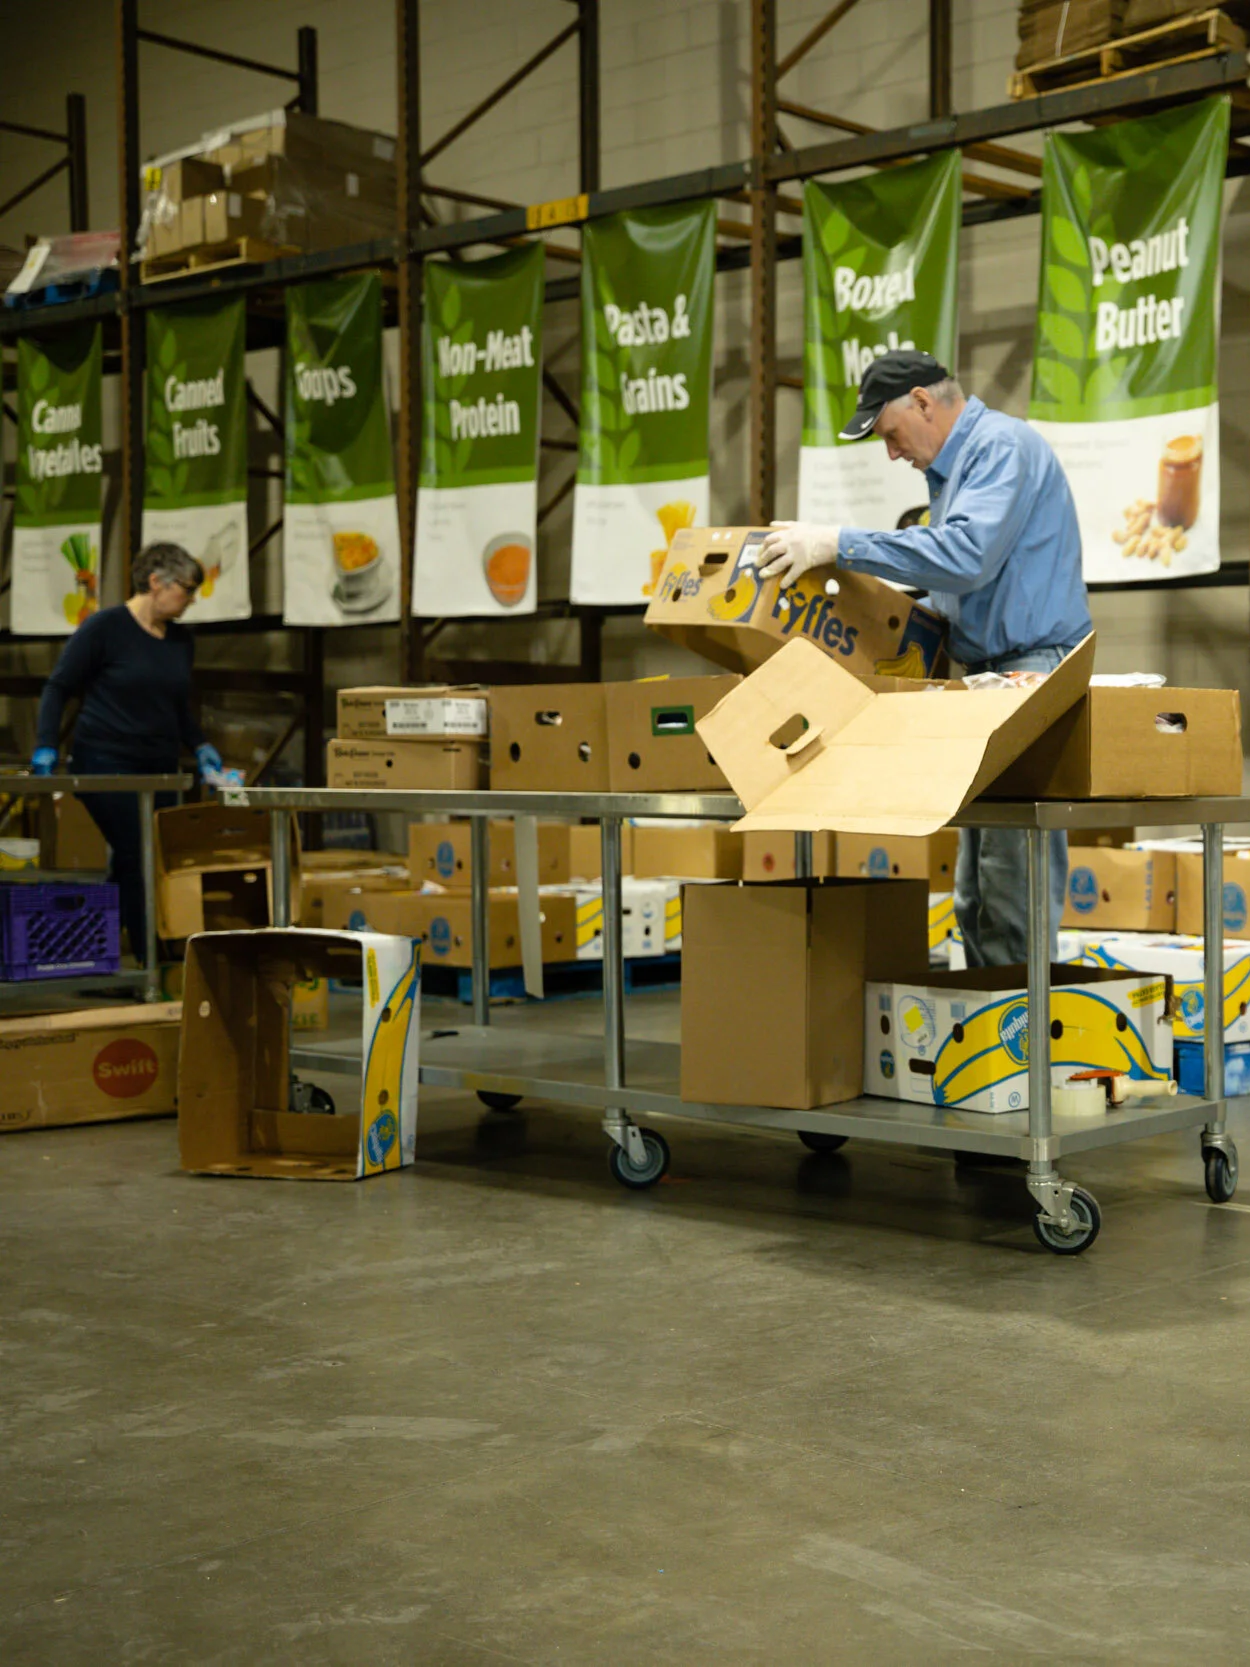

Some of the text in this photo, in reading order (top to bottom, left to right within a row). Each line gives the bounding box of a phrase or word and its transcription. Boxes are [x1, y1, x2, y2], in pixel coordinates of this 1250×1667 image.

[1089, 218, 1190, 287] Peanut
[833, 254, 916, 313] Boxed
[603, 294, 691, 347] Pasta &
[1094, 296, 1186, 352] Butter
[437, 324, 535, 378] Non-Meat
[164, 367, 225, 412] Canned
[172, 419, 222, 460] Fruits
[450, 393, 521, 441] Protein
[98, 1058, 157, 1079] Swift
